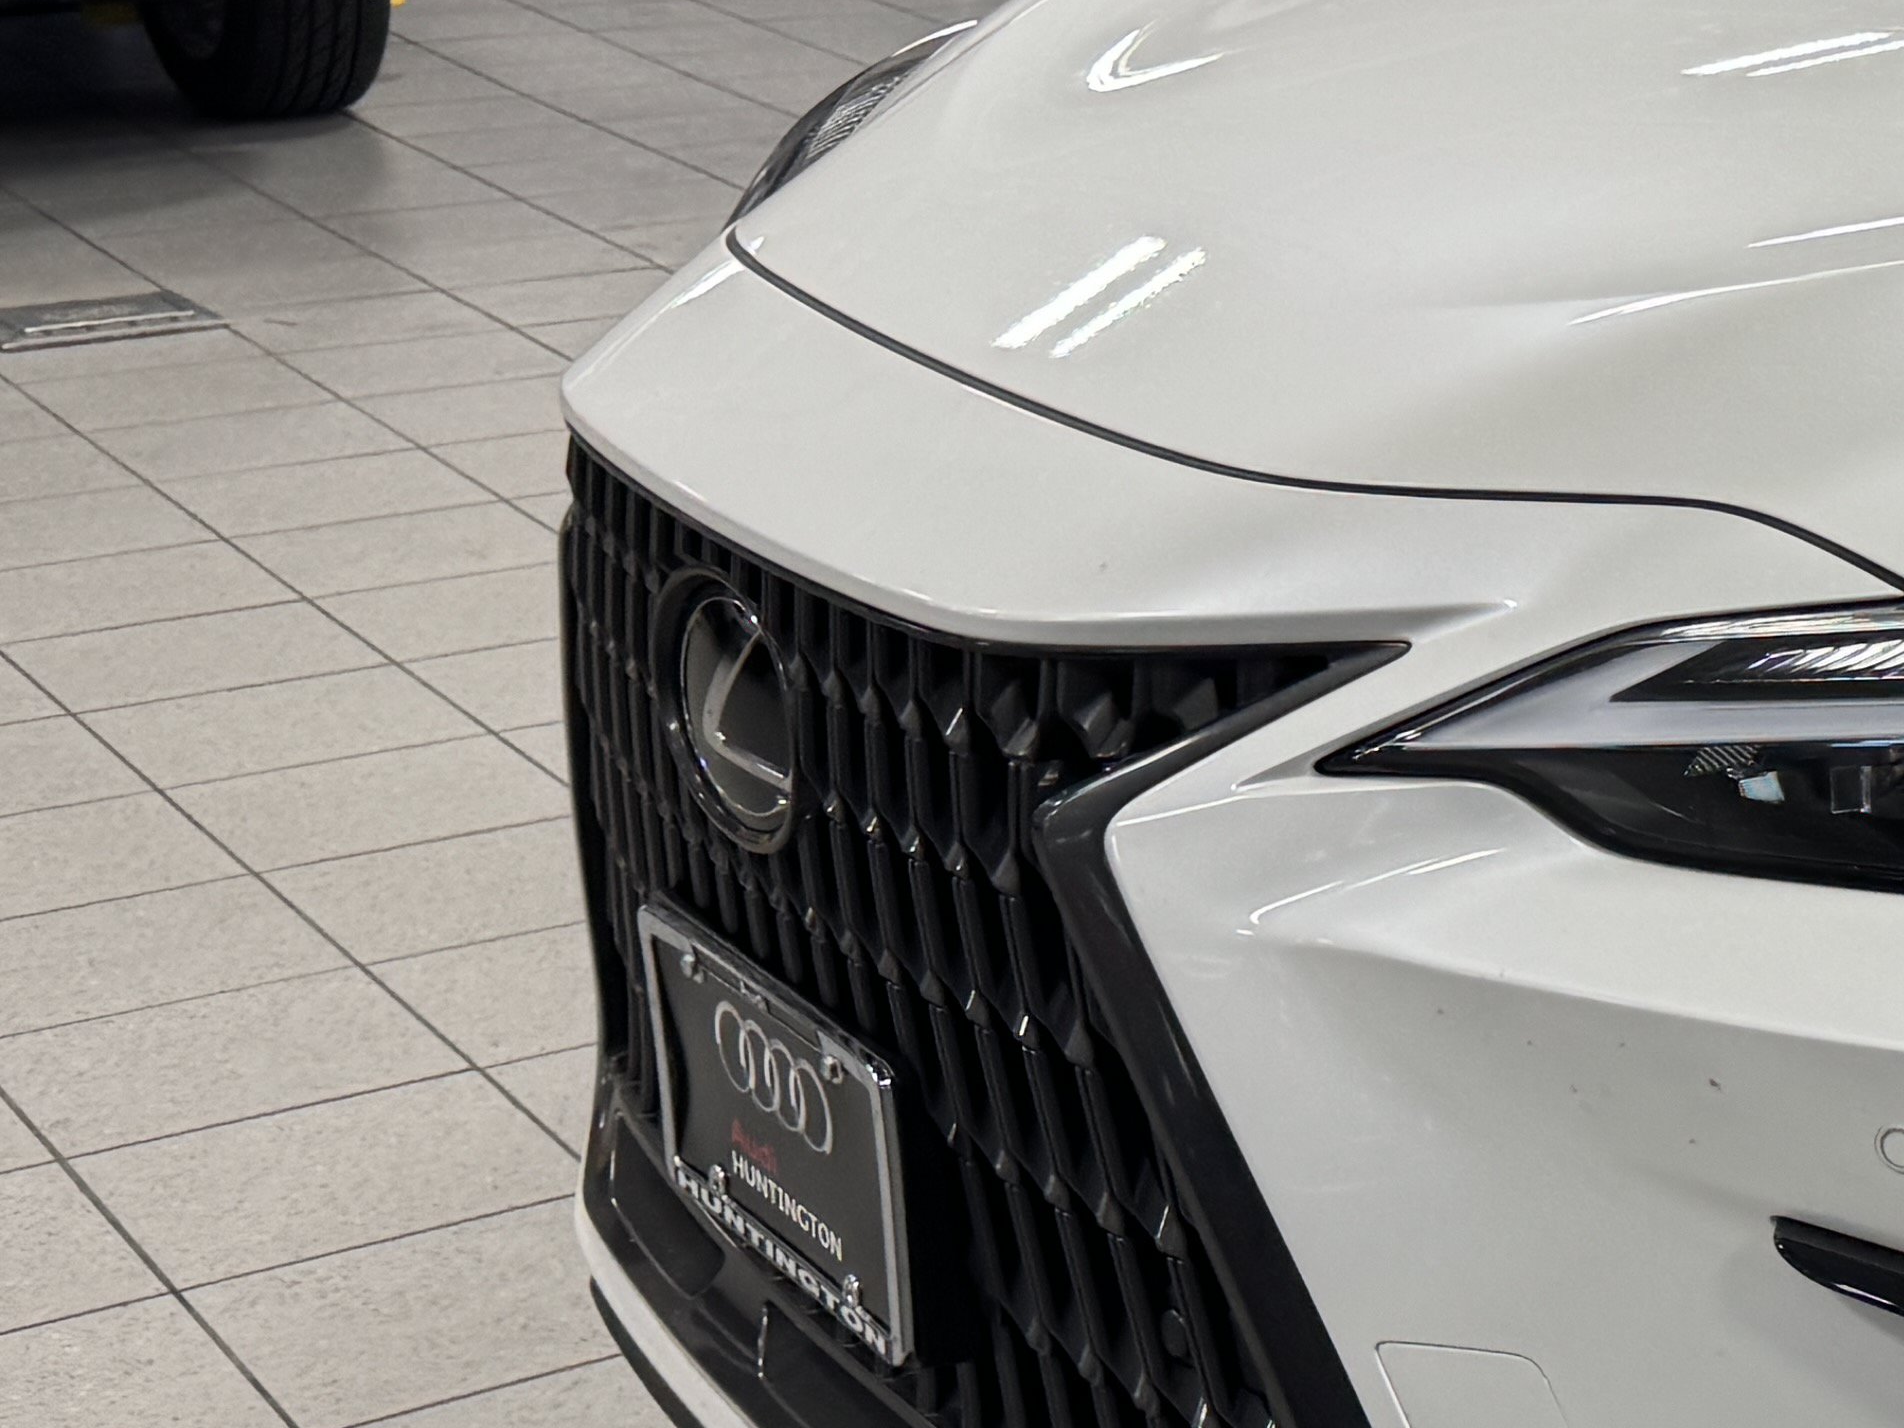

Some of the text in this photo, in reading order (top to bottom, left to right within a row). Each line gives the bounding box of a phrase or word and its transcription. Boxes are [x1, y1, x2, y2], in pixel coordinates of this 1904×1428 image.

[731, 1118, 776, 1172] Audi
[731, 1149, 842, 1261] HUNTINGTON
[677, 1168, 887, 1355] HUNTINGTON
